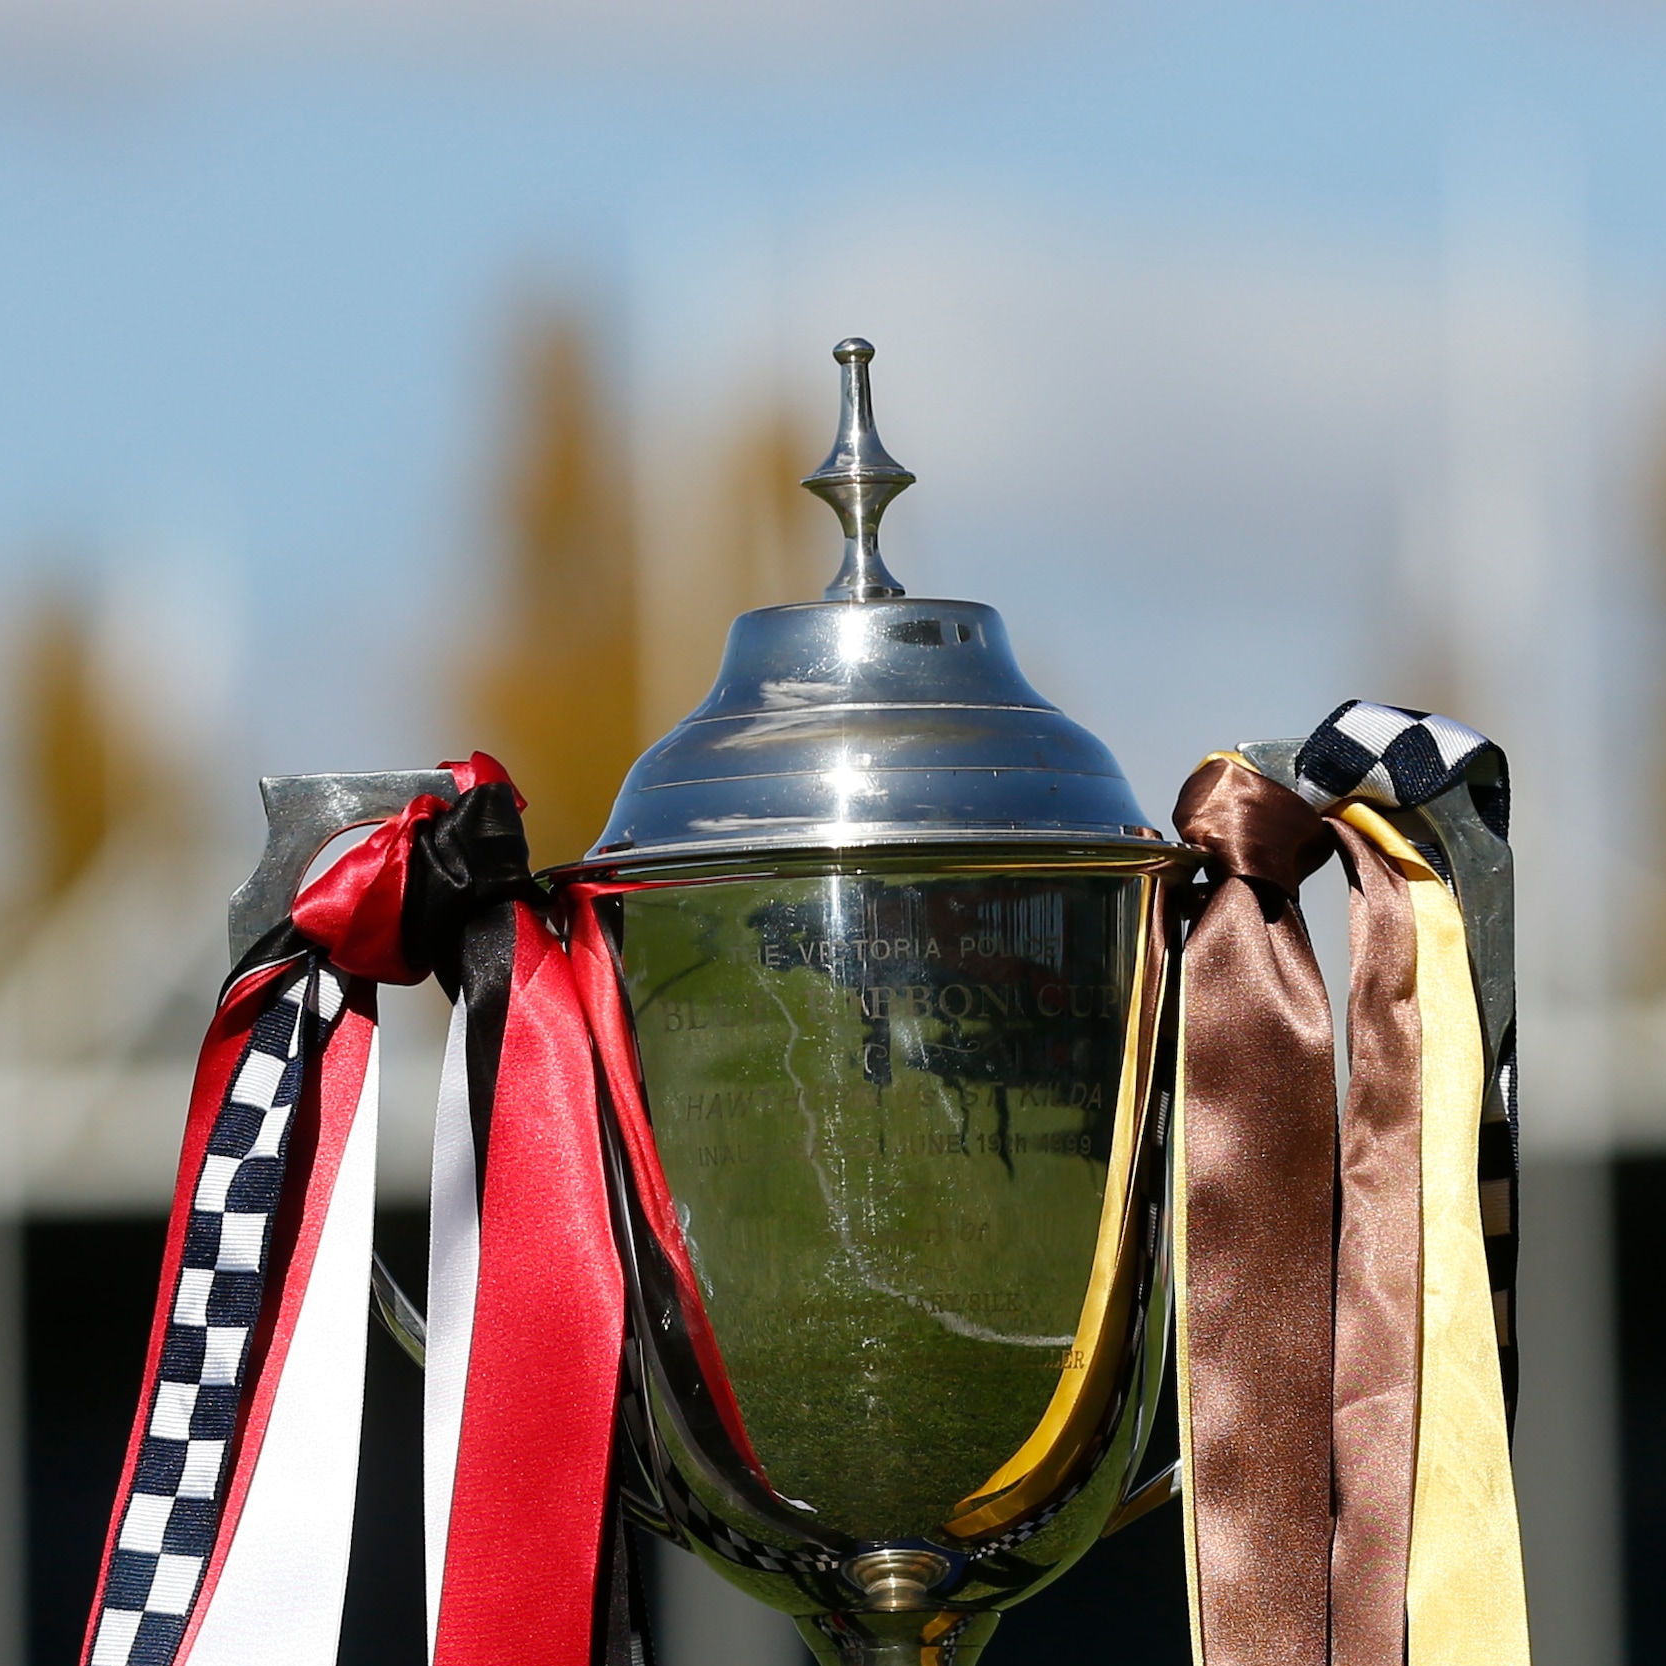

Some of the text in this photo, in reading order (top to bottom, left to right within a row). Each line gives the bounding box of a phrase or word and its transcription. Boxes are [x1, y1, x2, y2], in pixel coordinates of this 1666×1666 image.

[798, 936, 941, 964] VICTORIA
[960, 936, 1058, 959] POLICE
[1038, 983, 1120, 1019] CUP
[964, 1080, 1004, 1108] ST
[1019, 1081, 1103, 1109] KILDA
[1043, 1132, 1092, 1155] 1999
